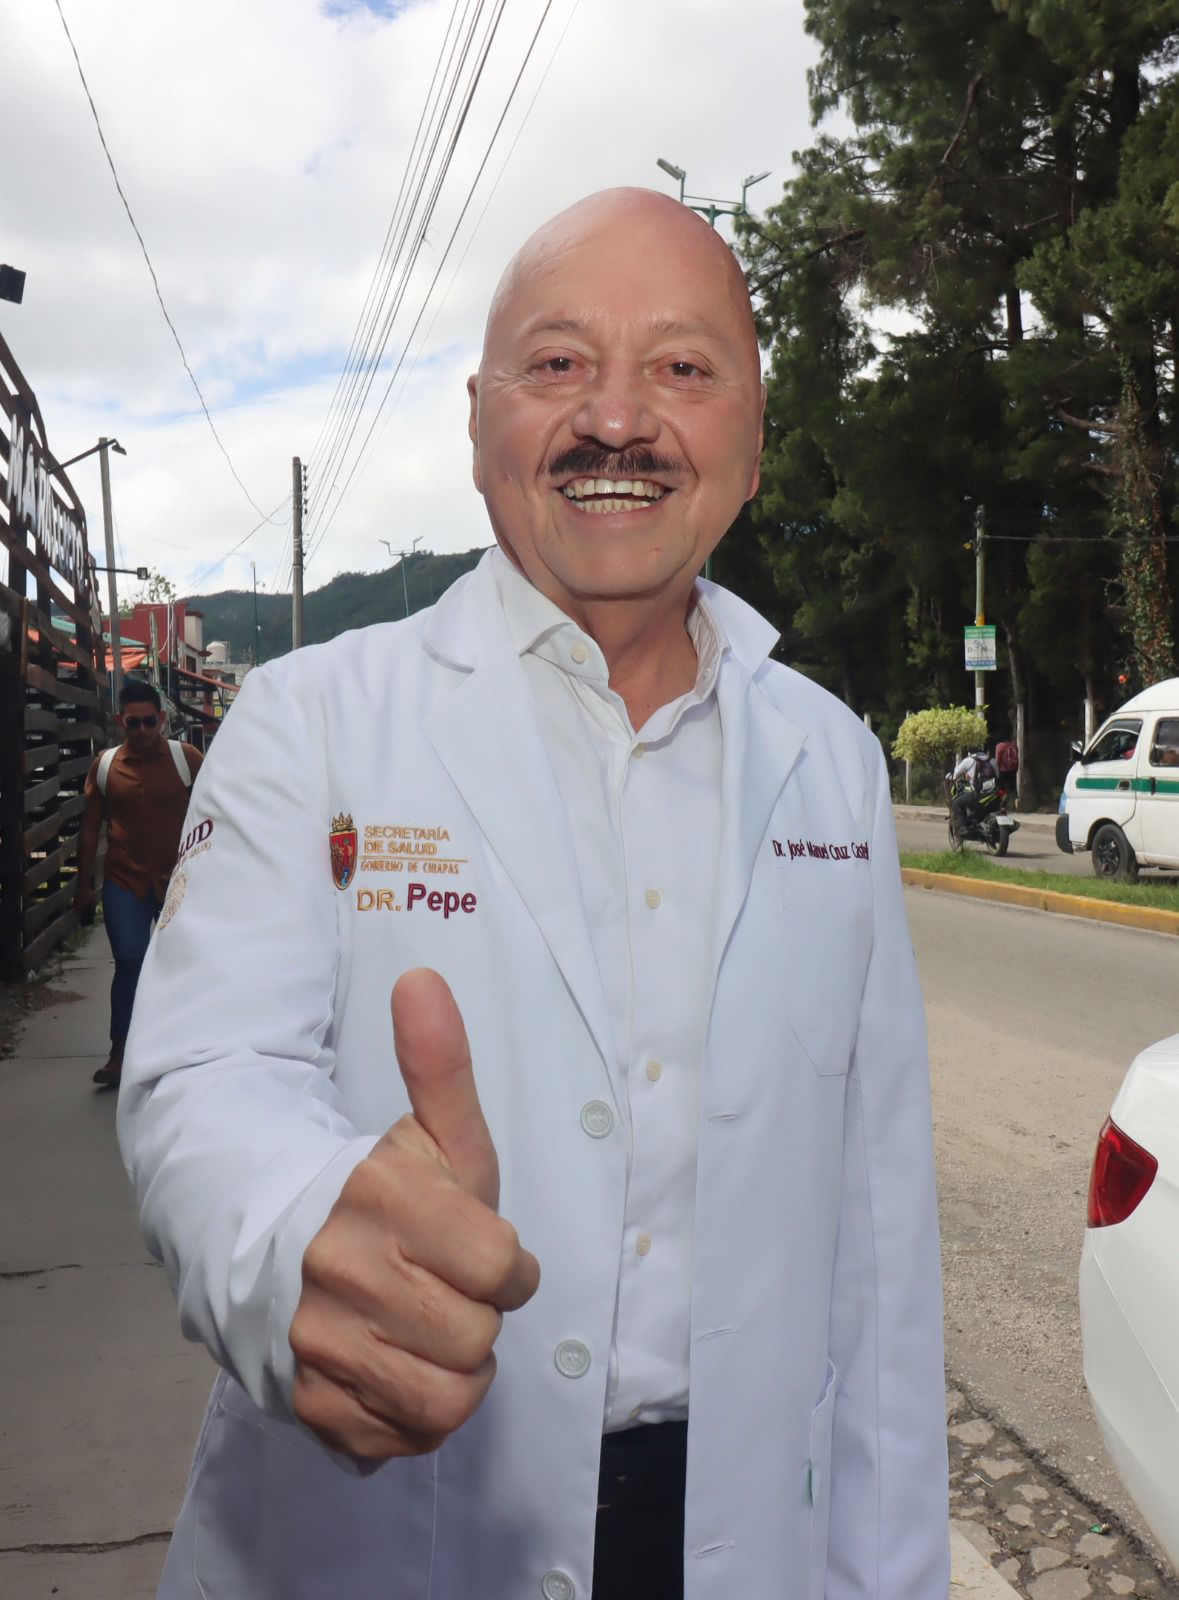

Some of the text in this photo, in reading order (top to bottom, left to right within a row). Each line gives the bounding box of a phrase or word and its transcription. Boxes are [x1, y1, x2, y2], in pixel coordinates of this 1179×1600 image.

[364, 826, 450, 841] SECRETARÍA
[364, 840, 438, 855] DE SALUD
[408, 861, 417, 873] DE
[356, 883, 478, 919] DR. Pepe
